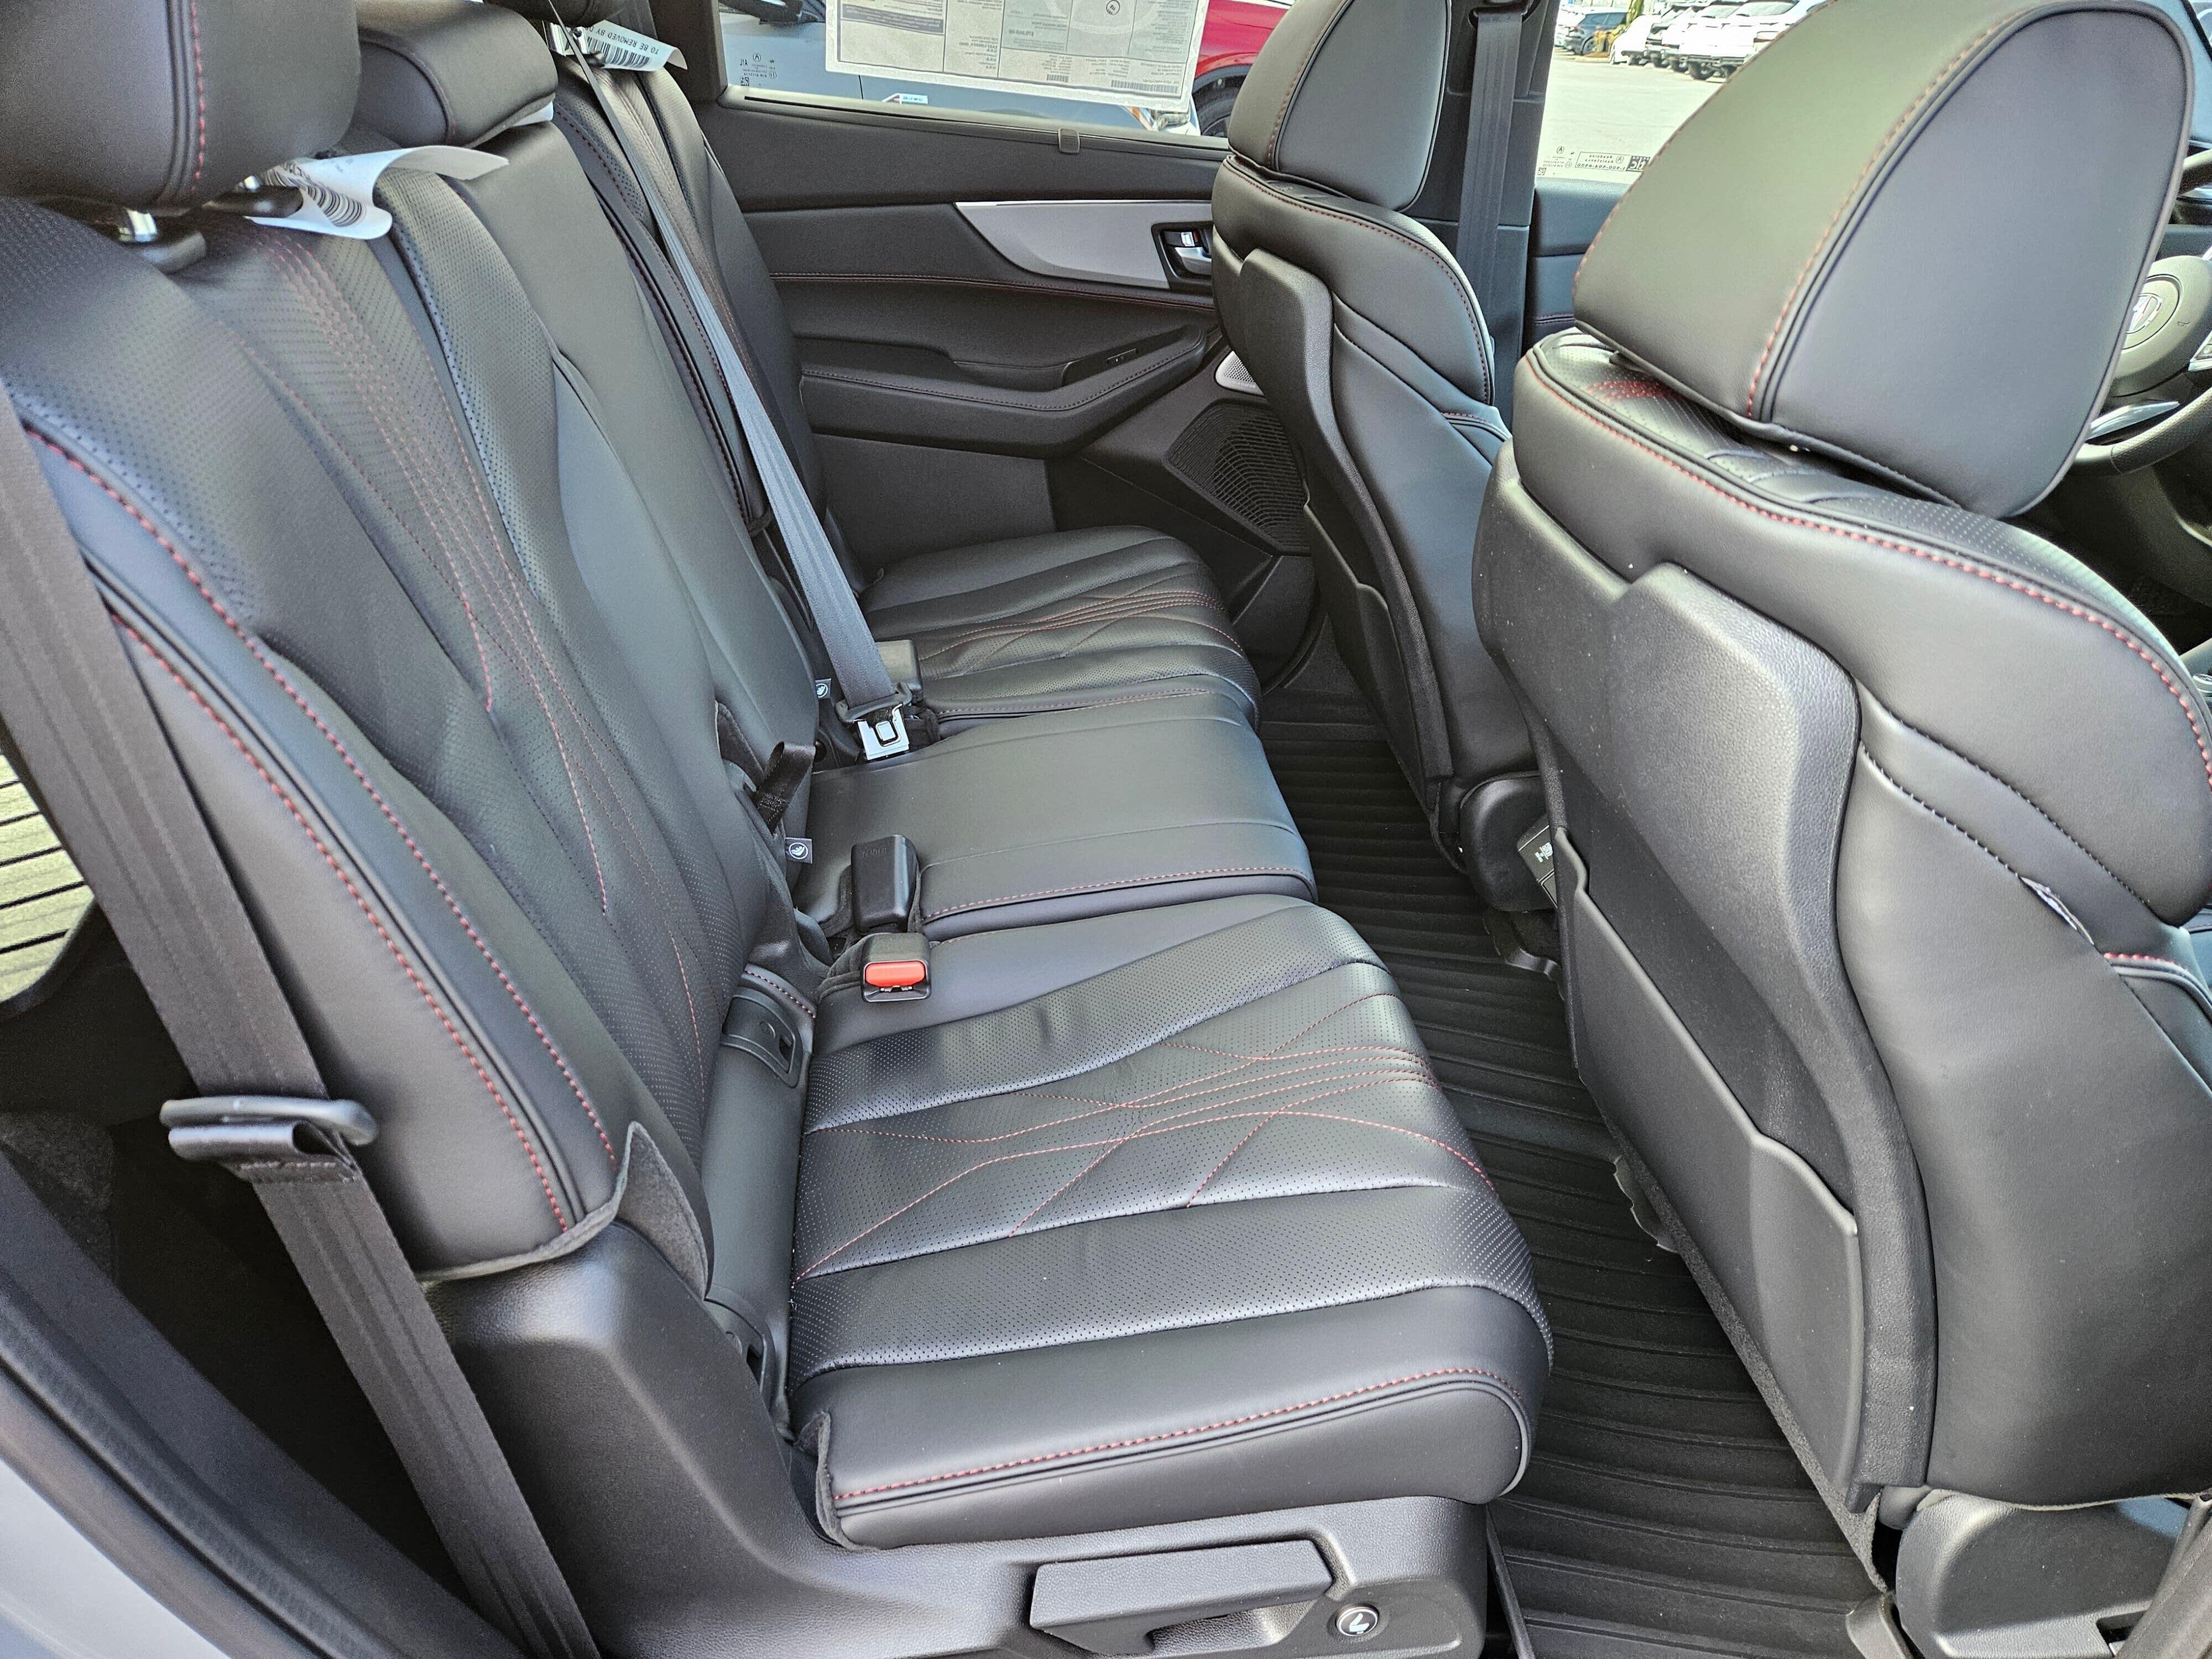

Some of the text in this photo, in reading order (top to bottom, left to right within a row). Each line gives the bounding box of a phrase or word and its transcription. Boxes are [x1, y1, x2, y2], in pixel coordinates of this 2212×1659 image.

[596, 28, 606, 36] BY
[608, 32, 637, 46] REMOVED
[639, 43, 649, 51] BE
[651, 46, 659, 55] TO
